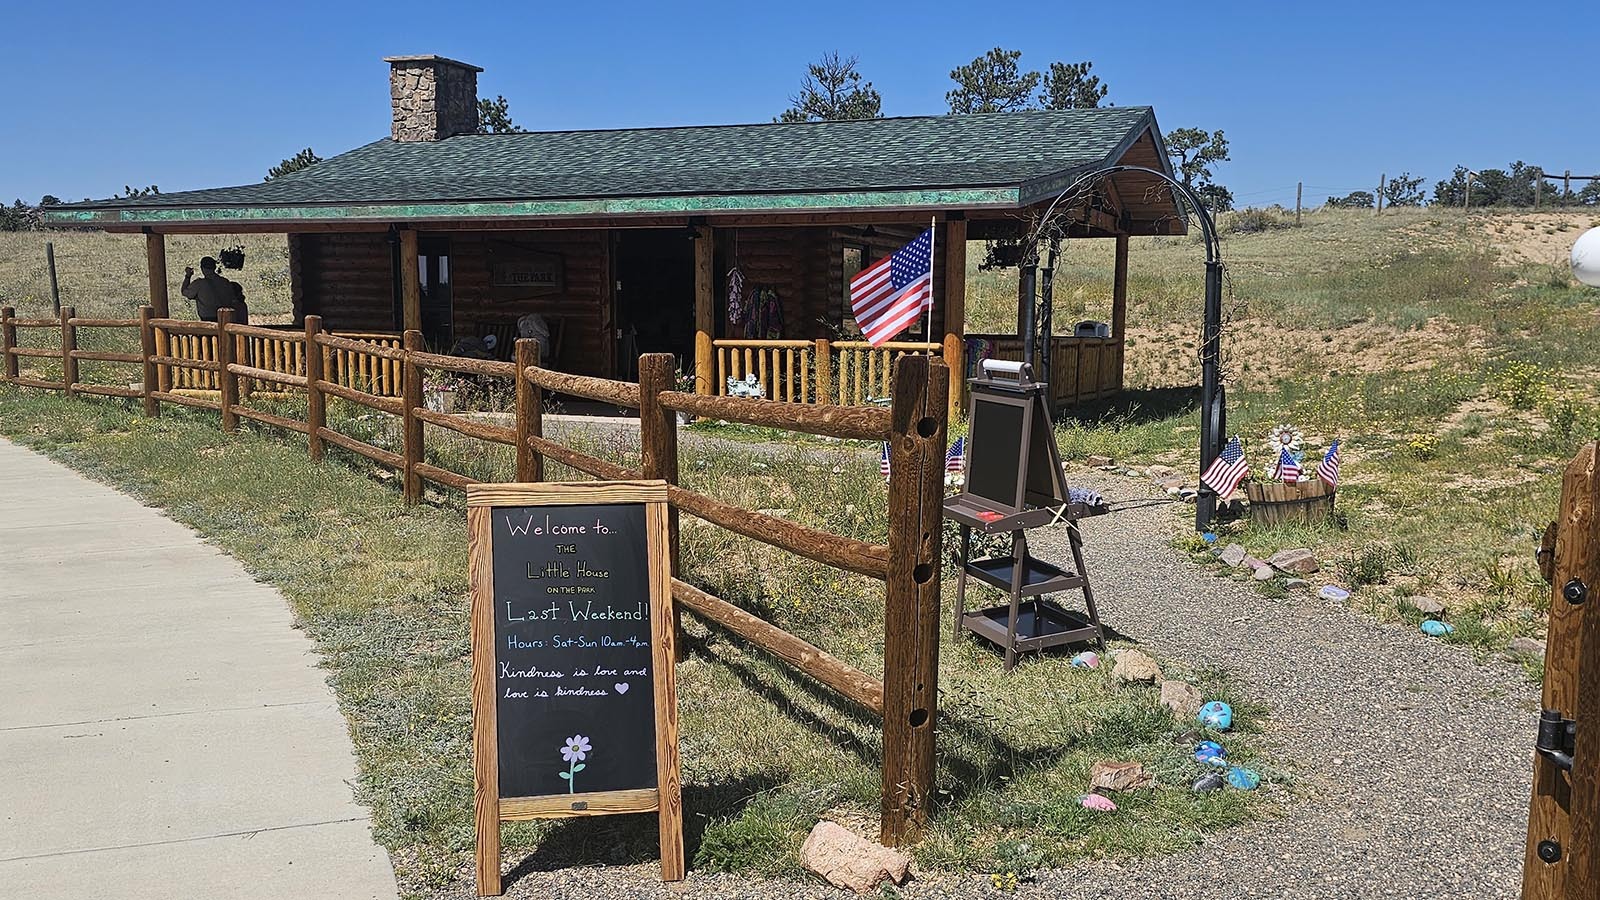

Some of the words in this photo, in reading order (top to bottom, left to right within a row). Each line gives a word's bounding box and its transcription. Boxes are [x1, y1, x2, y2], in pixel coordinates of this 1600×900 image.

[505, 514, 586, 536] Welcome
[593, 518, 617, 534] to...
[556, 545, 576, 553] THE
[527, 561, 570, 579] Little
[577, 561, 609, 579] House
[546, 586, 559, 594] ON
[559, 586, 576, 594] THE
[577, 586, 596, 594] PARK
[506, 601, 560, 621] Last
[568, 600, 649, 621] Weekend!
[507, 635, 548, 649] Hours:
[552, 635, 598, 648] Sat-Sun
[499, 661, 564, 679] Kindness
[572, 667, 589, 677] is
[594, 665, 618, 676] love
[623, 667, 647, 677] and
[503, 688, 529, 699] love
[534, 688, 549, 698] is
[554, 686, 609, 697] kindness
